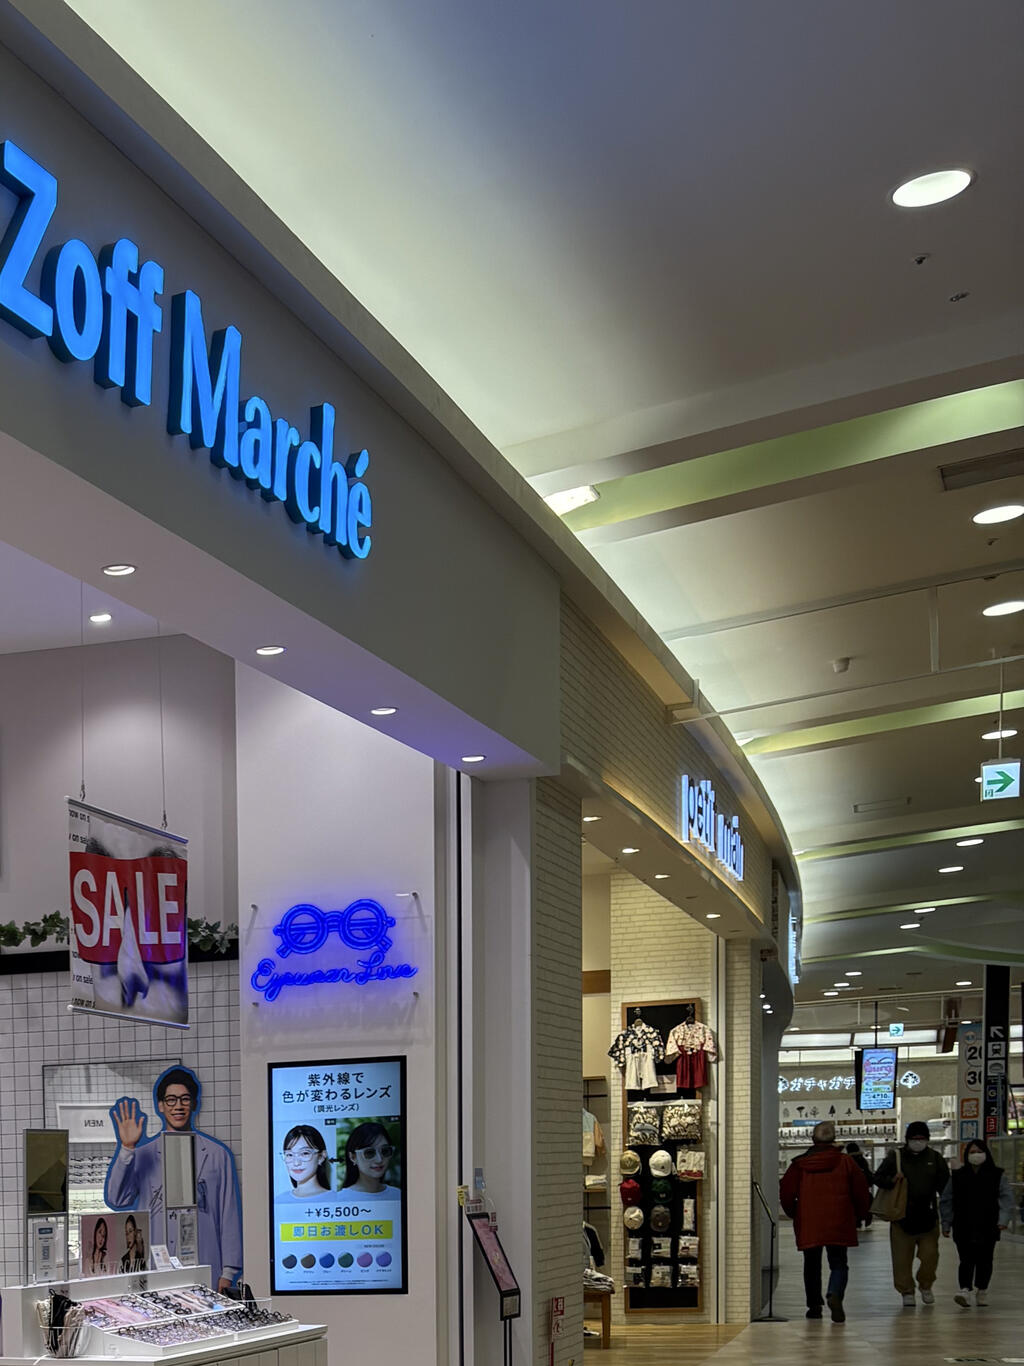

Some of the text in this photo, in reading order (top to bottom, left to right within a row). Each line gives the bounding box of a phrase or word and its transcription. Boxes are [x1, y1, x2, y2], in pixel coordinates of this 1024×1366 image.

[168, 289, 373, 560] Marché
[73, 868, 182, 948] SALE
[307, 1071, 365, 1087] 紫外線で
[282, 1085, 392, 1104] 色が変わるレンズ
[292, 1224, 384, 1238] 即日お渡しOK
